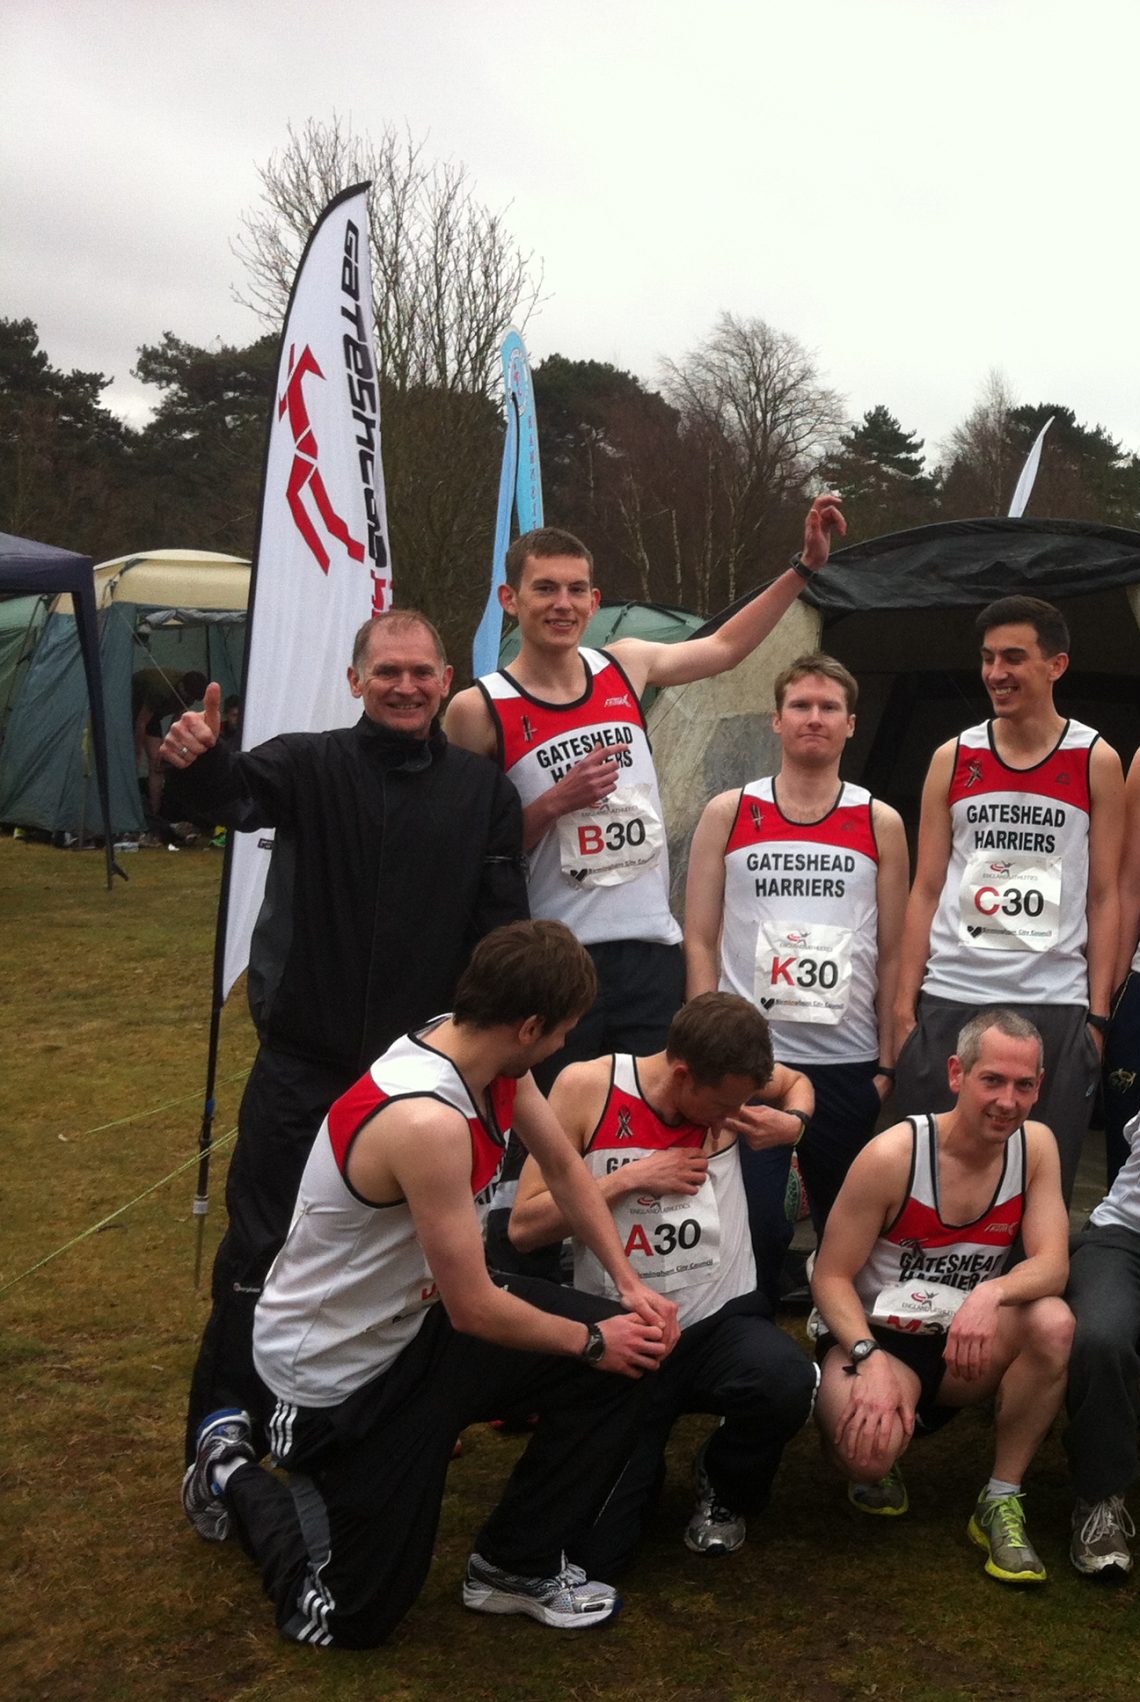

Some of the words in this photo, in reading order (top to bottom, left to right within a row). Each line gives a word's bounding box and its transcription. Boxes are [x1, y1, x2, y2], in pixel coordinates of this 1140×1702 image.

[536, 726, 633, 768] GATESHEAD
[967, 804, 1066, 828] GATESHEAD
[578, 818, 646, 855] B30
[974, 831, 1055, 853] HARRIERS
[747, 853, 855, 872] GATESHEAD
[755, 878, 845, 897] HARRIERS
[975, 886, 1044, 917] C30
[771, 956, 838, 989] K30
[625, 1218, 701, 1257] A30
